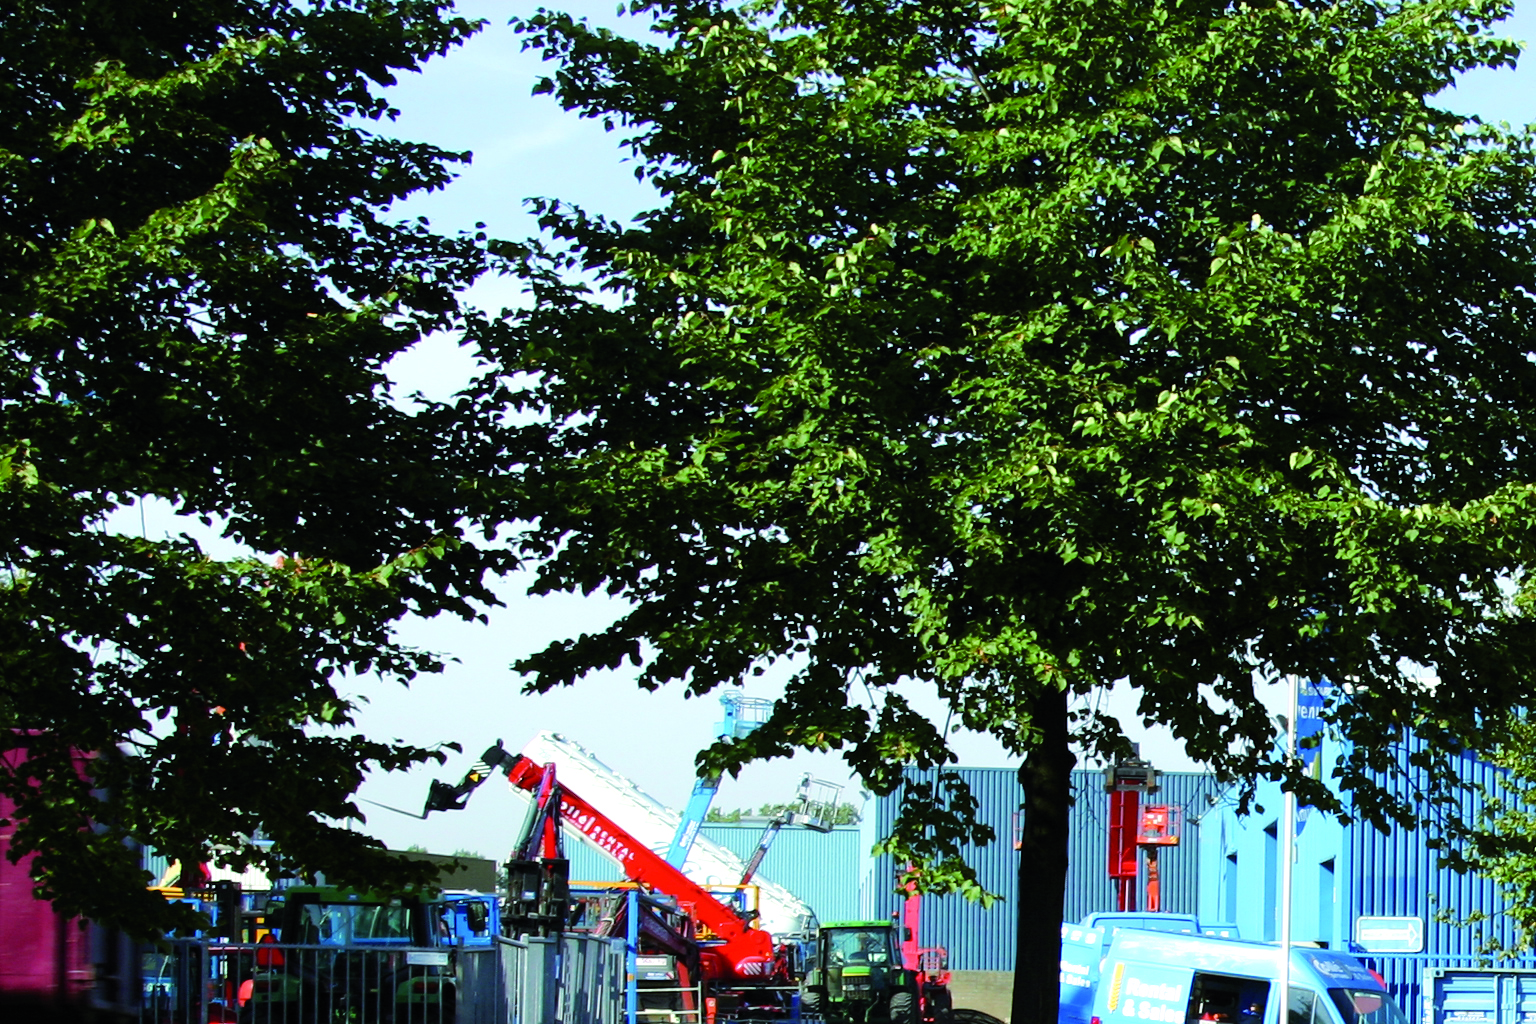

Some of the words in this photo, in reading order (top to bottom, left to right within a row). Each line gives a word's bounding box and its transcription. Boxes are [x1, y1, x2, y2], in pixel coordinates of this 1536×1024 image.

[1126, 978, 1182, 1002] Rental
[1122, 999, 1135, 1017] &
[1138, 1001, 1186, 1024] Sales
